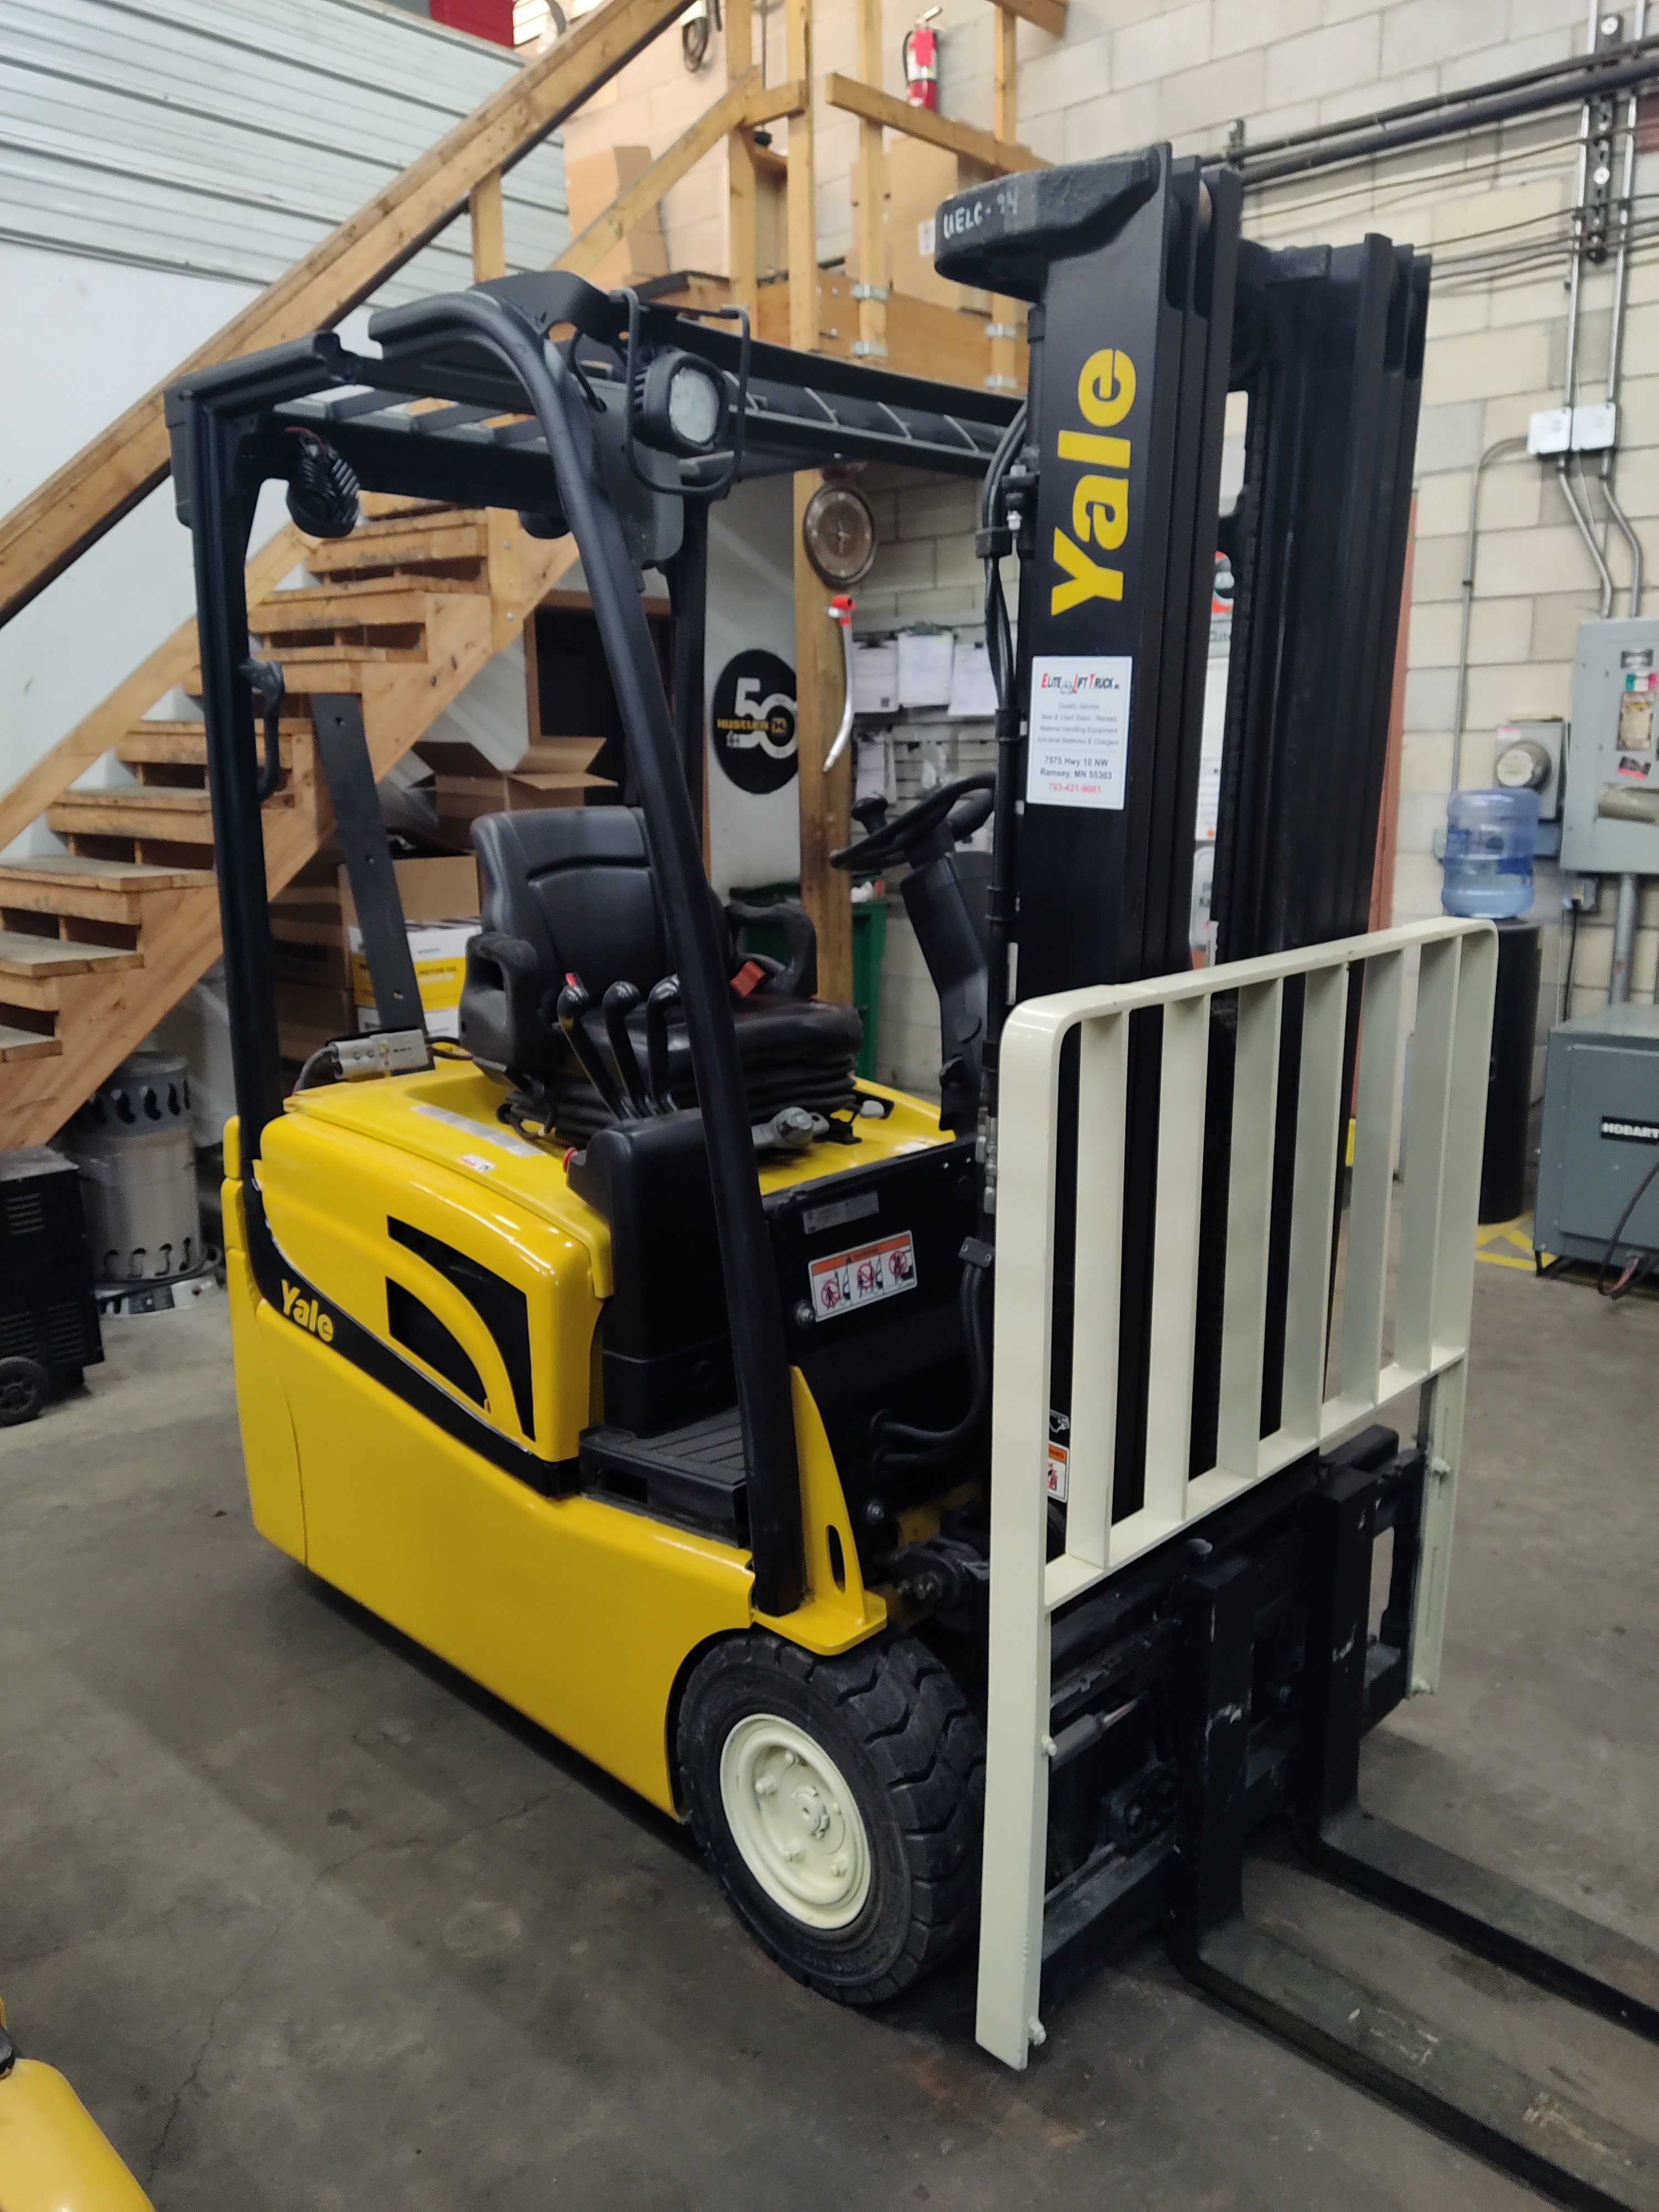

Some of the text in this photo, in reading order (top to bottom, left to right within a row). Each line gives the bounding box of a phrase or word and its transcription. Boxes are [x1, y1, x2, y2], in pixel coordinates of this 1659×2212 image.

[1051, 348, 1136, 616] Yale
[1064, 757, 1080, 768] Hwy
[1094, 758, 1109, 767] NW
[1074, 769, 1087, 778] MN
[281, 1279, 334, 1343] Yale
